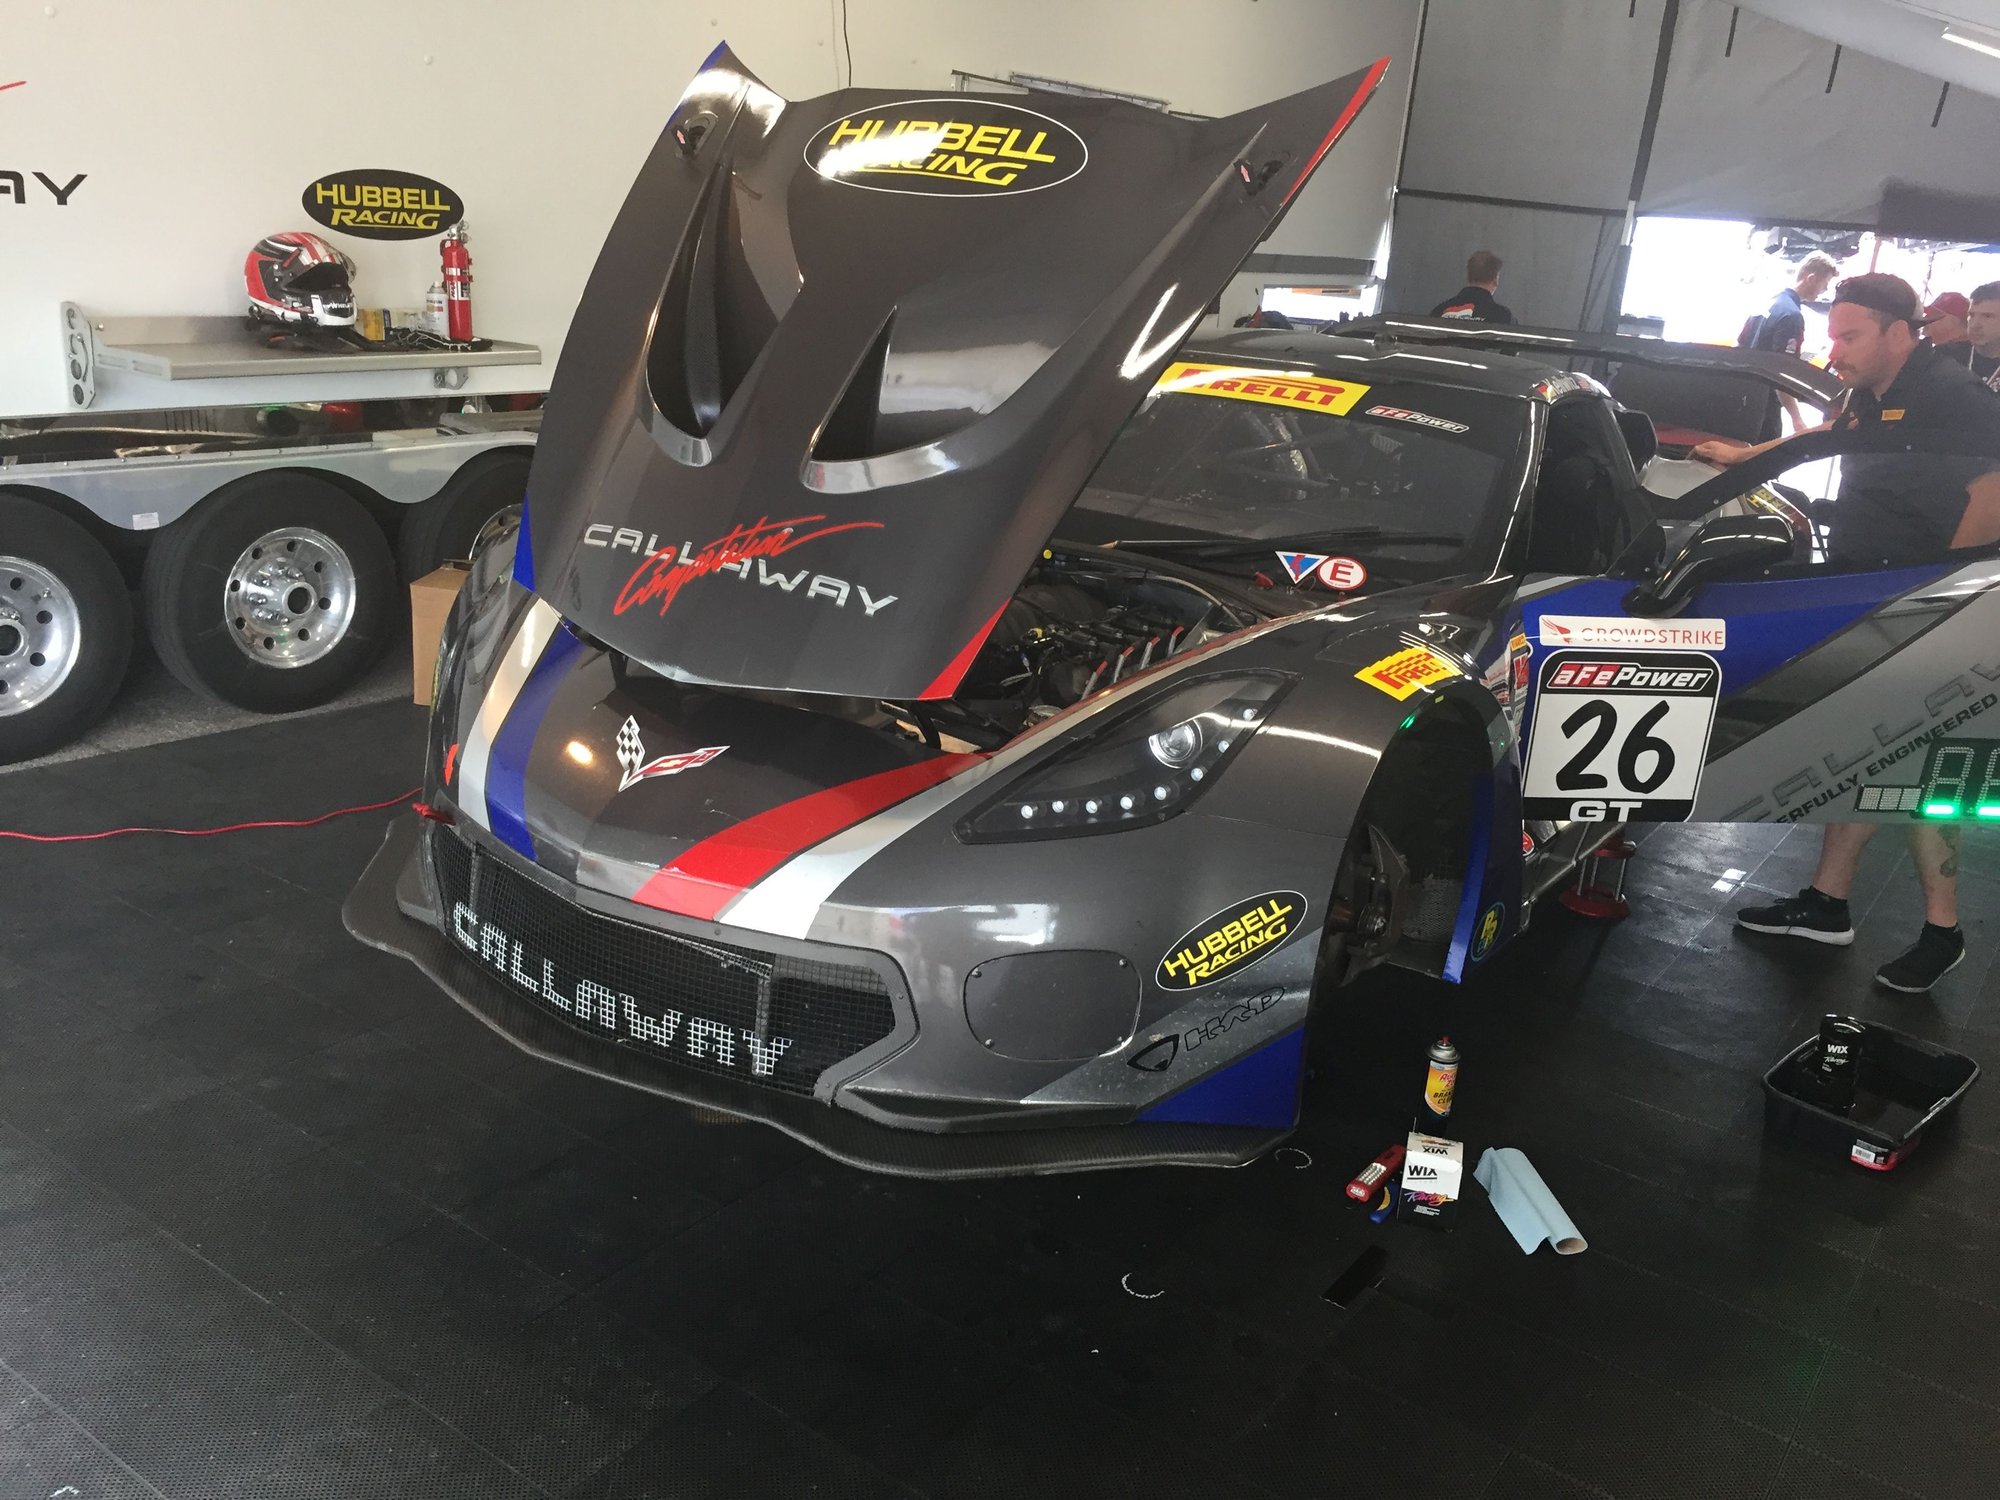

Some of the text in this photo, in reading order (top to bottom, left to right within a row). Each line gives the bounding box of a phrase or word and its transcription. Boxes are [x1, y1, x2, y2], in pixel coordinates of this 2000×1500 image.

[316, 183, 450, 211] HUBBELL
[331, 208, 441, 230] RACING
[1178, 368, 1346, 407] PRELLI
[584, 523, 899, 617] CALLAWAY
[1330, 563, 1354, 584] E
[1581, 627, 1724, 646] CROWDSTRIKE
[1556, 699, 1676, 795] 26
[1866, 693, 1998, 777] ENGINEERED
[1569, 800, 1643, 823] GT
[1164, 899, 1293, 977] HUBBELL
[1185, 917, 1288, 986] RACING
[453, 901, 794, 1076] CALLAWAY
[1828, 1044, 1849, 1054] WIX
[1422, 1146, 1449, 1155] WIX
[1404, 1190, 1455, 1207] Racing
